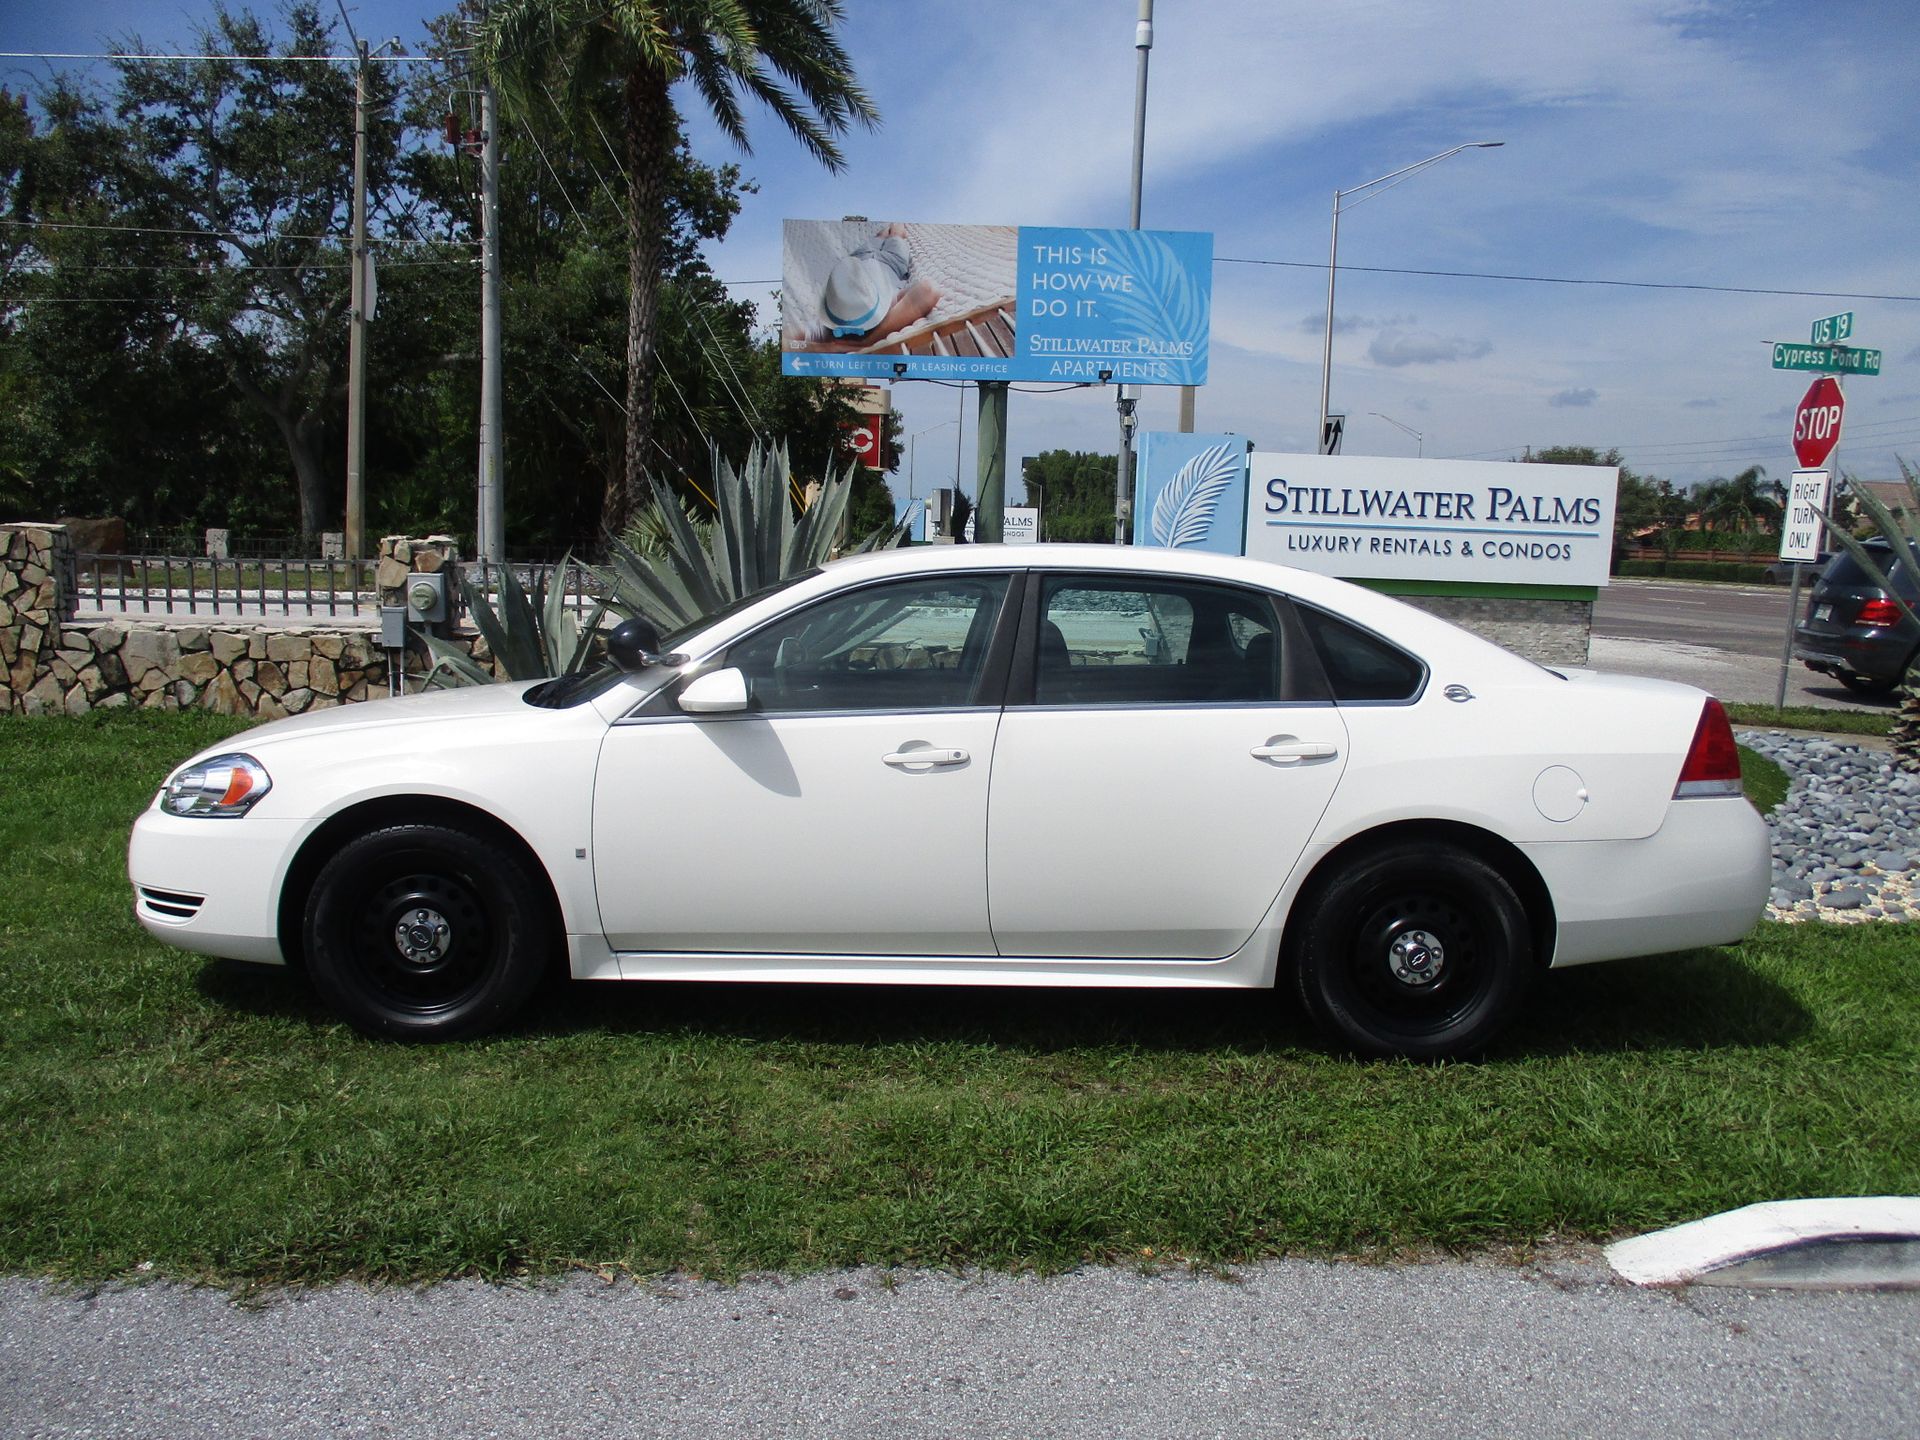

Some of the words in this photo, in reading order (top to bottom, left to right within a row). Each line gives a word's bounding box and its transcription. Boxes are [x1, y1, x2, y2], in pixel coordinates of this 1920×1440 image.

[1033, 246, 1081, 265] THIS
[1091, 247, 1107, 265] IS
[1032, 272, 1092, 291] HOW
[1097, 274, 1134, 292] WE
[1032, 299, 1067, 317] DO
[1076, 300, 1098, 317] IT.
[1814, 320, 1830, 343] US
[1835, 315, 1848, 339] 19
[1030, 334, 1132, 354] STILLWATER
[1136, 337, 1193, 356] PALMS
[1774, 344, 1825, 367] Cypress
[1830, 348, 1860, 367] Pond
[1864, 351, 1880, 369] Rd
[815, 360, 844, 369] TURN
[848, 361, 871, 370] LEFT
[876, 361, 890, 370] TO
[922, 363, 967, 373] LEASING
[970, 364, 1008, 373] OFFICE
[1050, 360, 1168, 378] APARTMENTS
[1796, 405, 1840, 440] STOP
[1794, 483, 1821, 499] RIGHT
[1265, 478, 1475, 520] STILLWATER
[1485, 486, 1600, 525] PALMS
[1003, 515, 1033, 526] ALMS
[1793, 507, 1815, 524] TURN
[1288, 534, 1362, 553] LUXURY
[1370, 537, 1451, 556] RENTALS
[1461, 541, 1474, 558] &
[1481, 541, 1572, 560] CONDOS
[1789, 531, 1812, 548] ONLY
